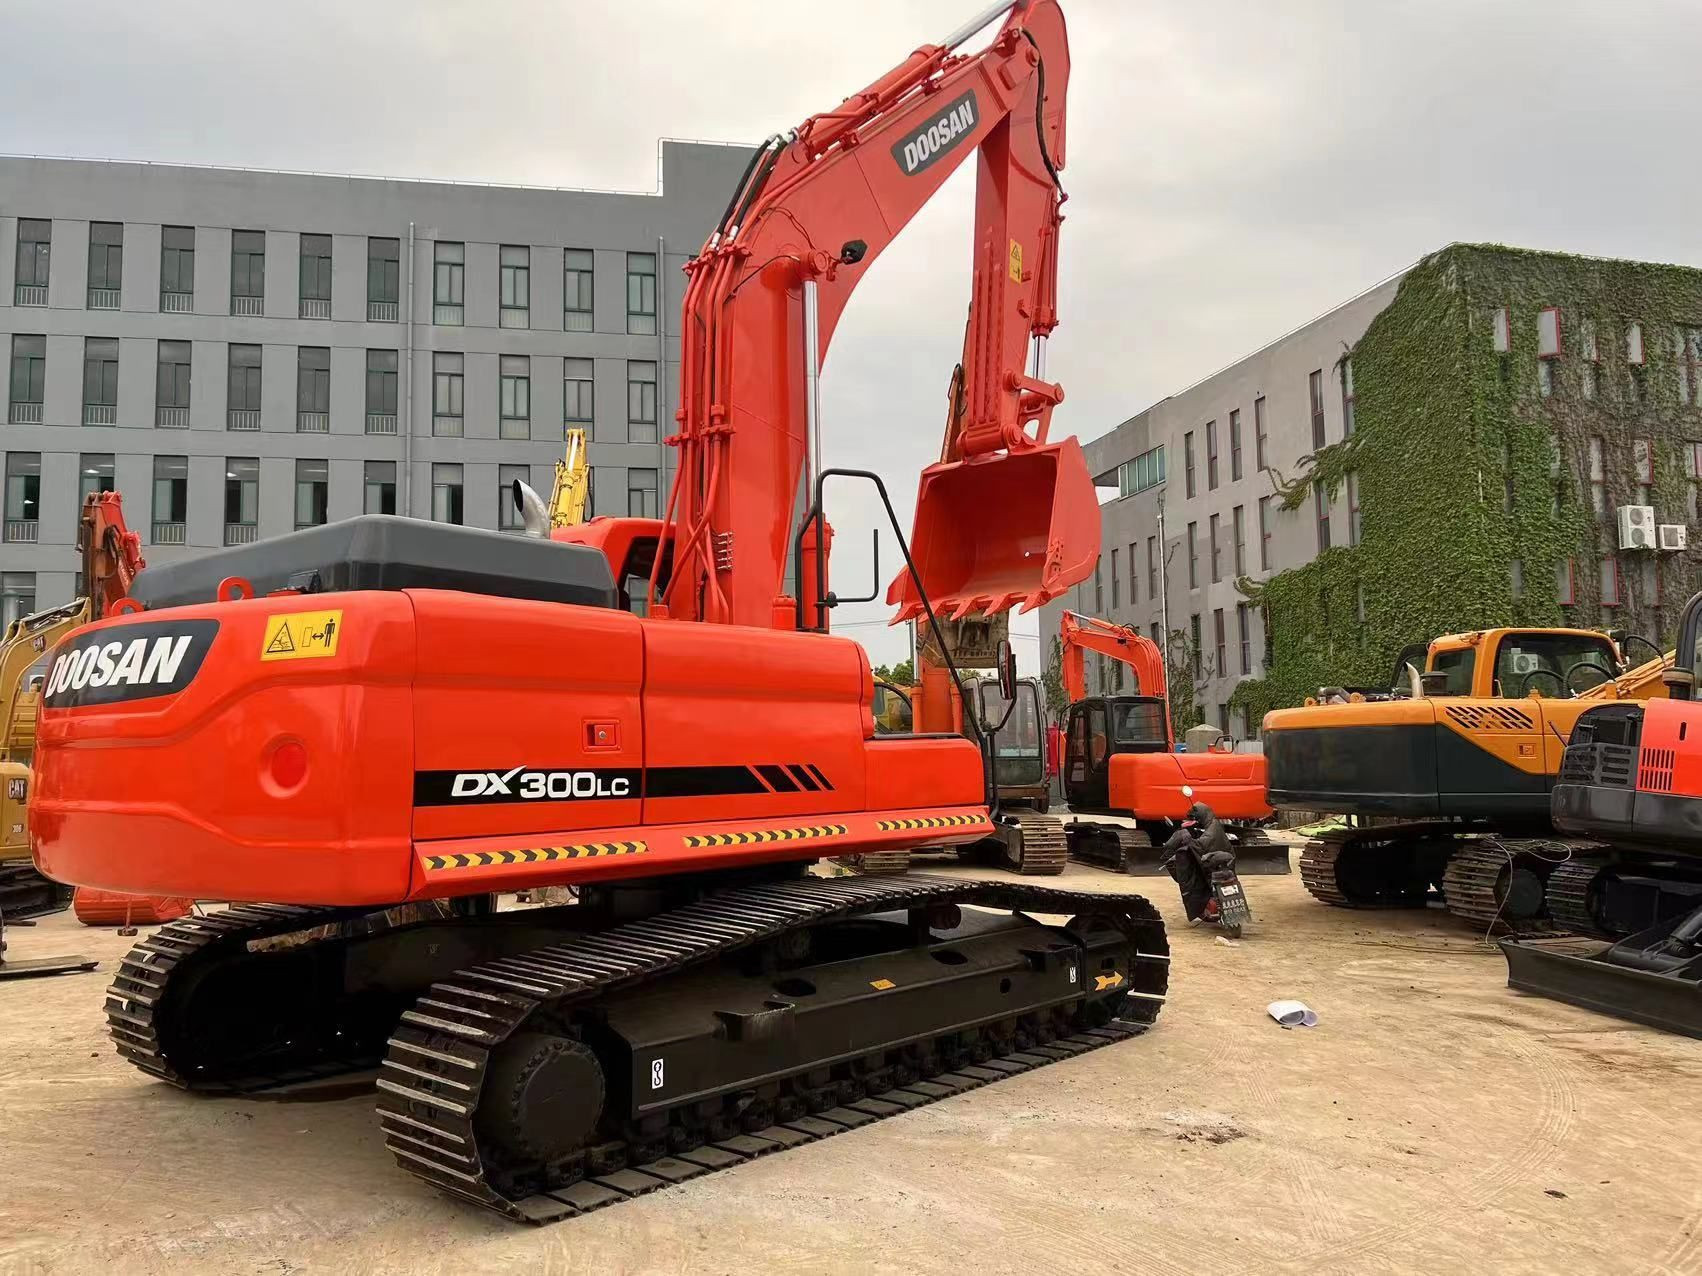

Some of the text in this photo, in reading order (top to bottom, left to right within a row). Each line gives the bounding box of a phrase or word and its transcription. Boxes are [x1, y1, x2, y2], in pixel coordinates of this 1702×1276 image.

[904, 100, 974, 172] DOOSAN
[44, 635, 193, 699] DOOSAN
[8, 778, 25, 799] CAT
[451, 765, 630, 799] DX300LC
